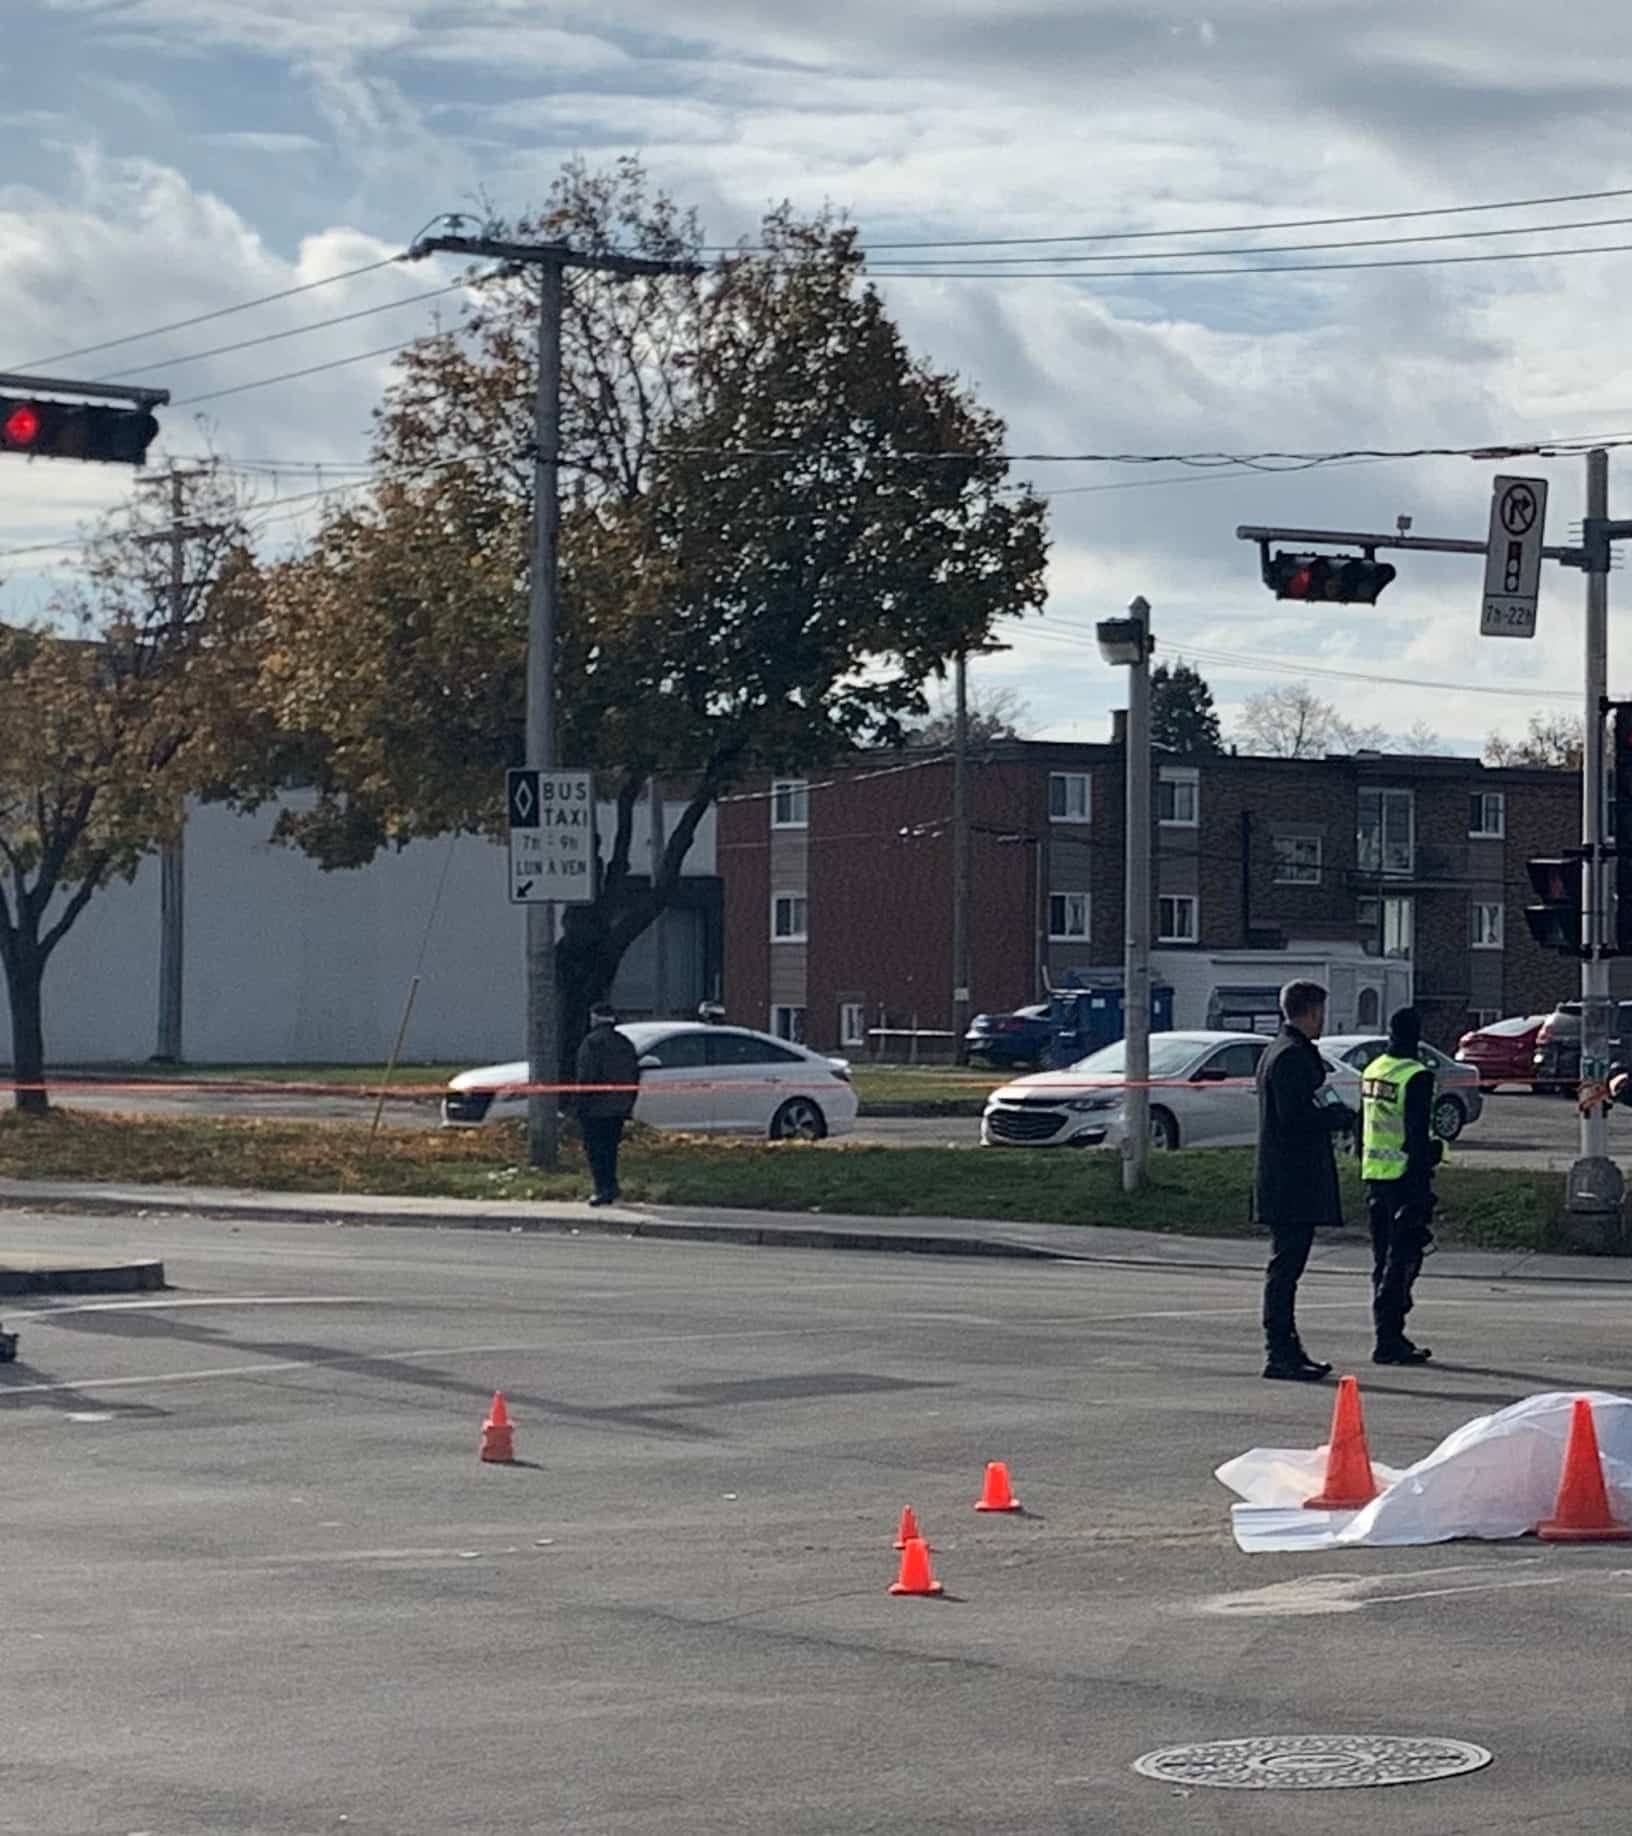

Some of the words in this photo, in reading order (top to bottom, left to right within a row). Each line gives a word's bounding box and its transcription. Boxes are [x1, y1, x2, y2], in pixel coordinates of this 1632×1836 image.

[543, 782, 587, 800] BUS
[545, 808, 588, 826] TAXI
[516, 860, 542, 876] LUN
[560, 860, 587, 876] VEN
